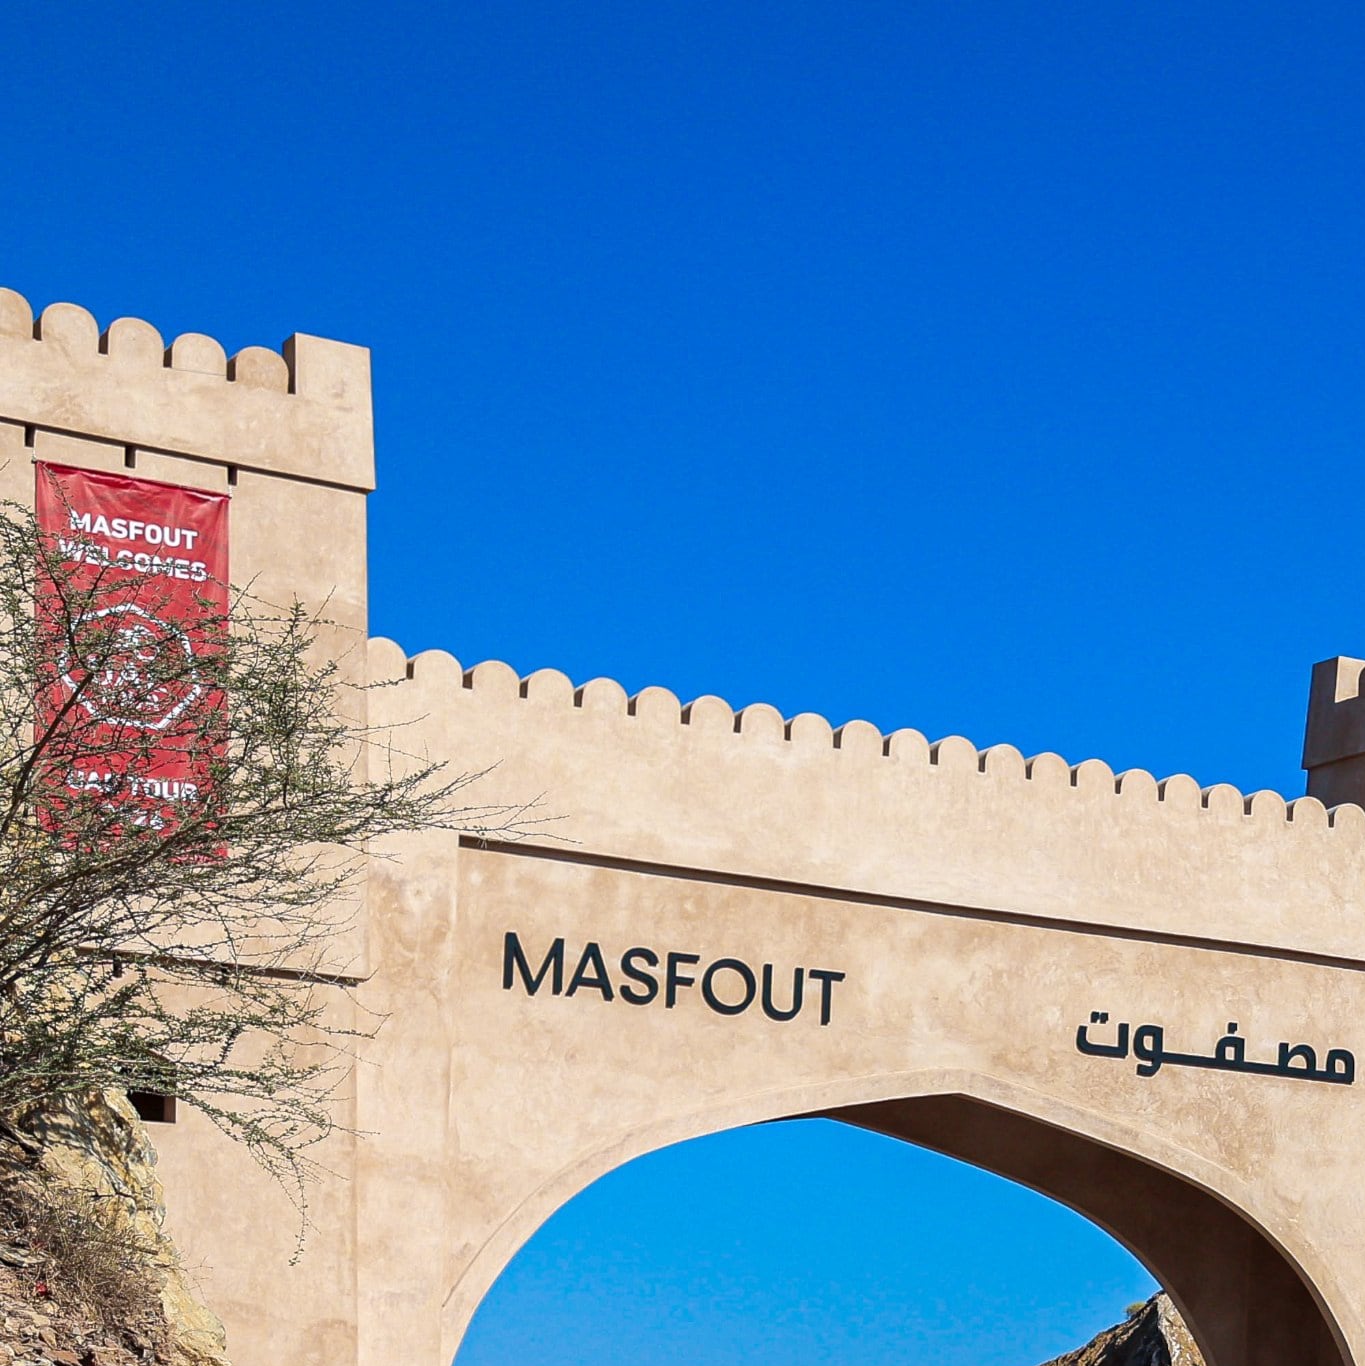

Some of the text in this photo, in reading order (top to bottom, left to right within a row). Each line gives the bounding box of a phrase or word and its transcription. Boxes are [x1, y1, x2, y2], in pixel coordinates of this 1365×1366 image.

[70, 510, 198, 549] MASFOUT
[58, 539, 208, 582] WELCOMES
[502, 931, 846, 1026] MASFOUT
[1076, 1011, 1355, 1085] مصفوت
